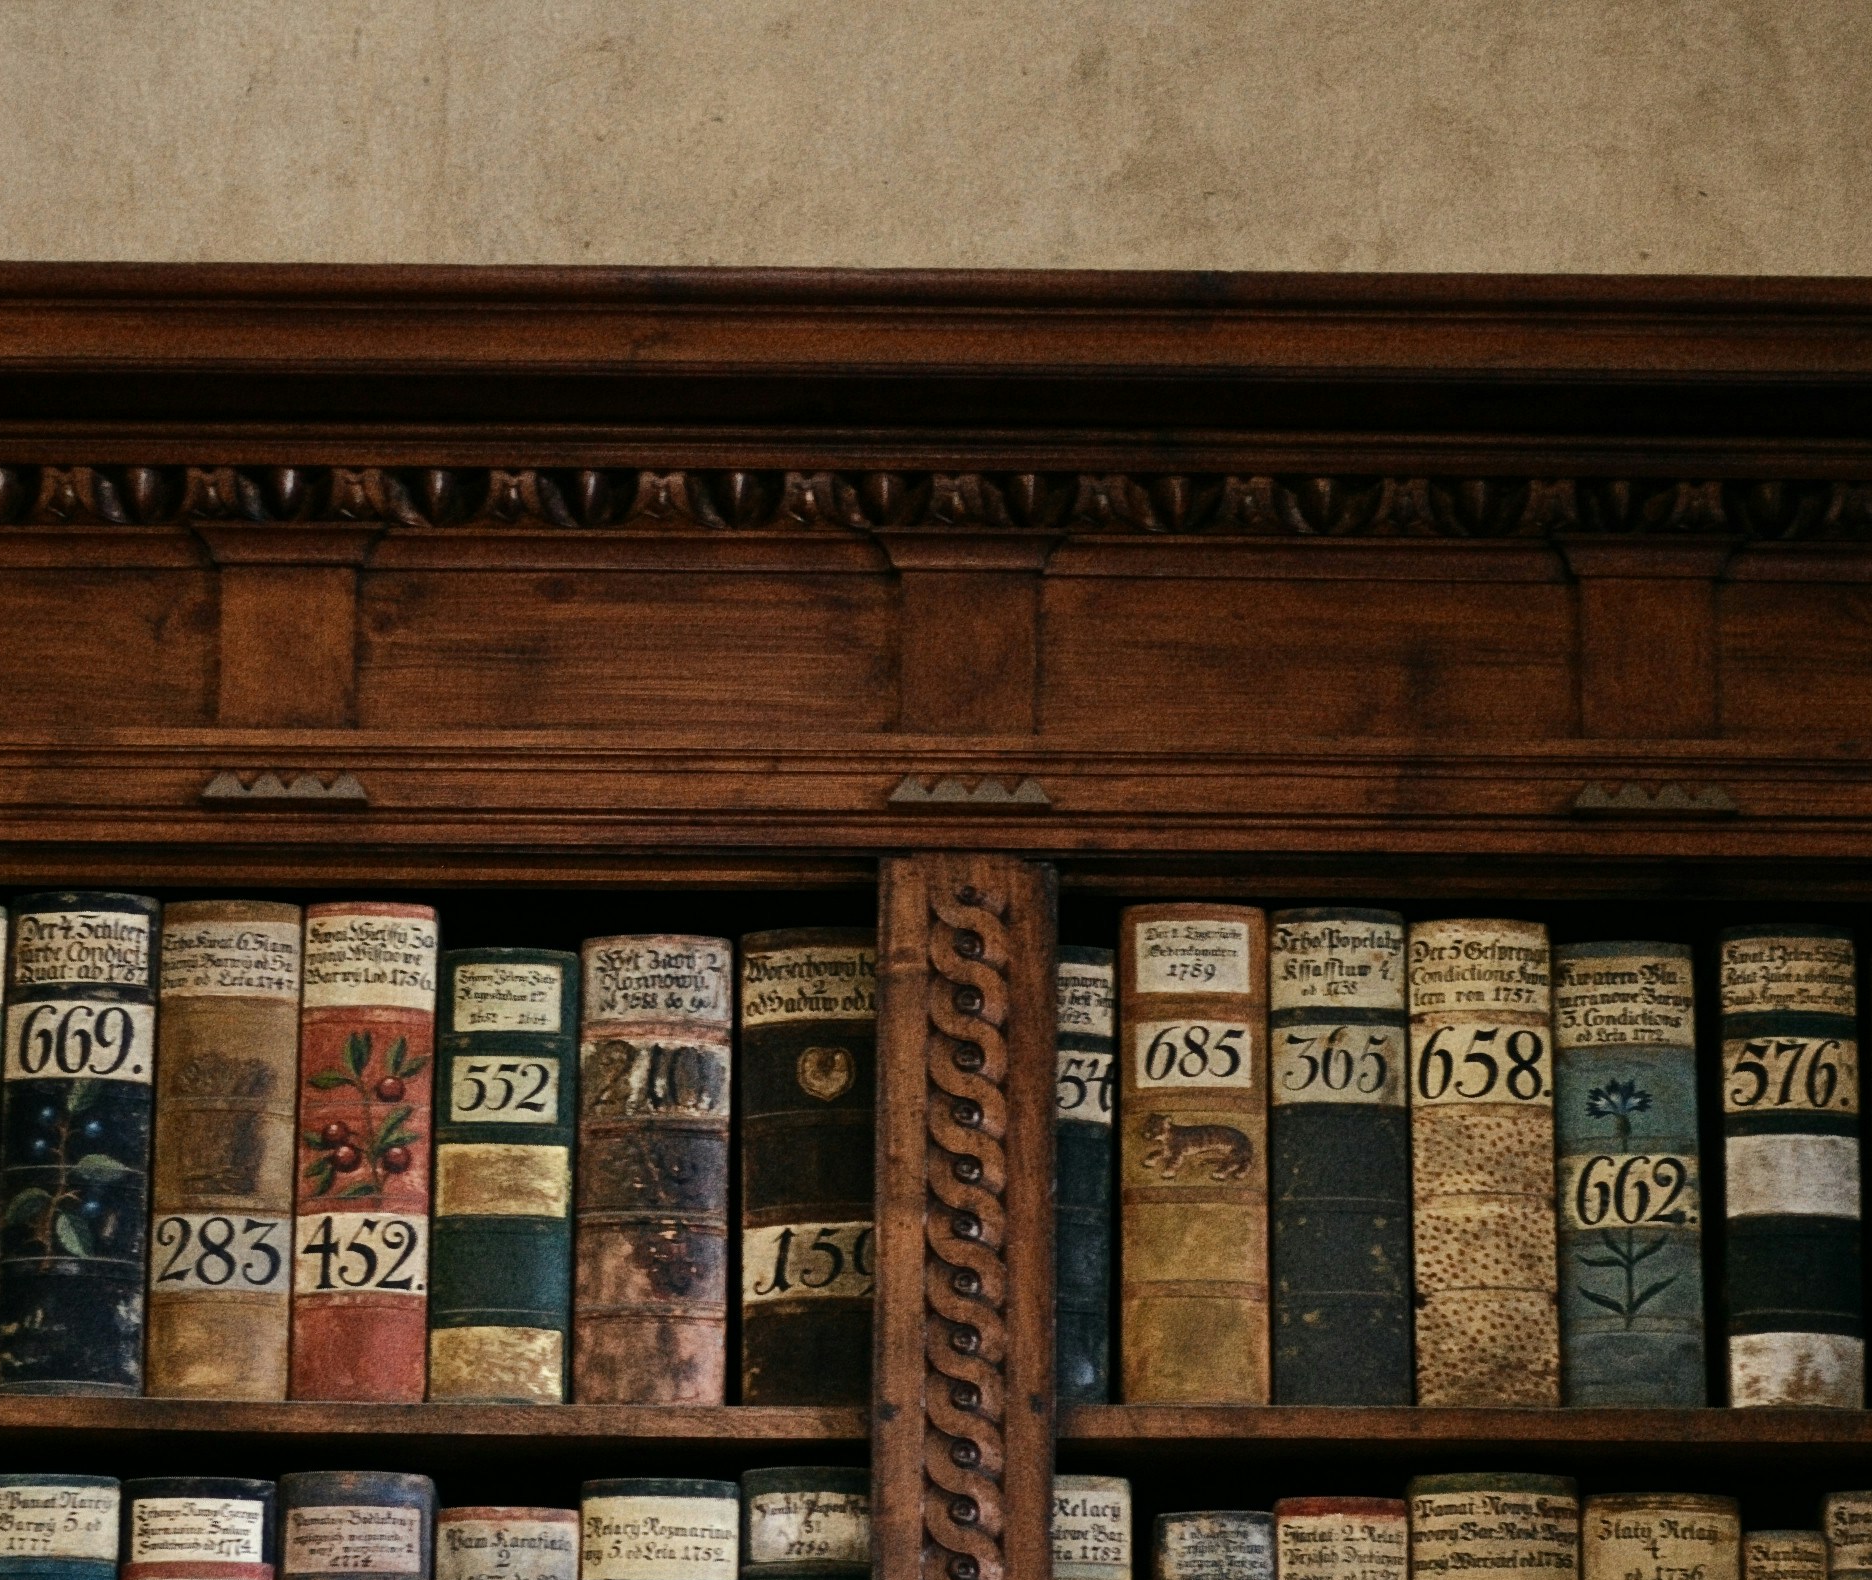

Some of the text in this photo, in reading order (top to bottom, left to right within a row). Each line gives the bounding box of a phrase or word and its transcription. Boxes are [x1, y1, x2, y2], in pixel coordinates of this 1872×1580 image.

[20, 1004, 143, 1076] 669.
[1145, 1026, 1245, 1083] 685
[1281, 1026, 1389, 1094] 365
[1417, 1025, 1552, 1100] 658.
[1729, 1040, 1849, 1107] 576.
[455, 1062, 551, 1113] 552
[1575, 1155, 1698, 1227] 662.
[156, 1215, 281, 1287] 283
[301, 1217, 426, 1292] 452.
